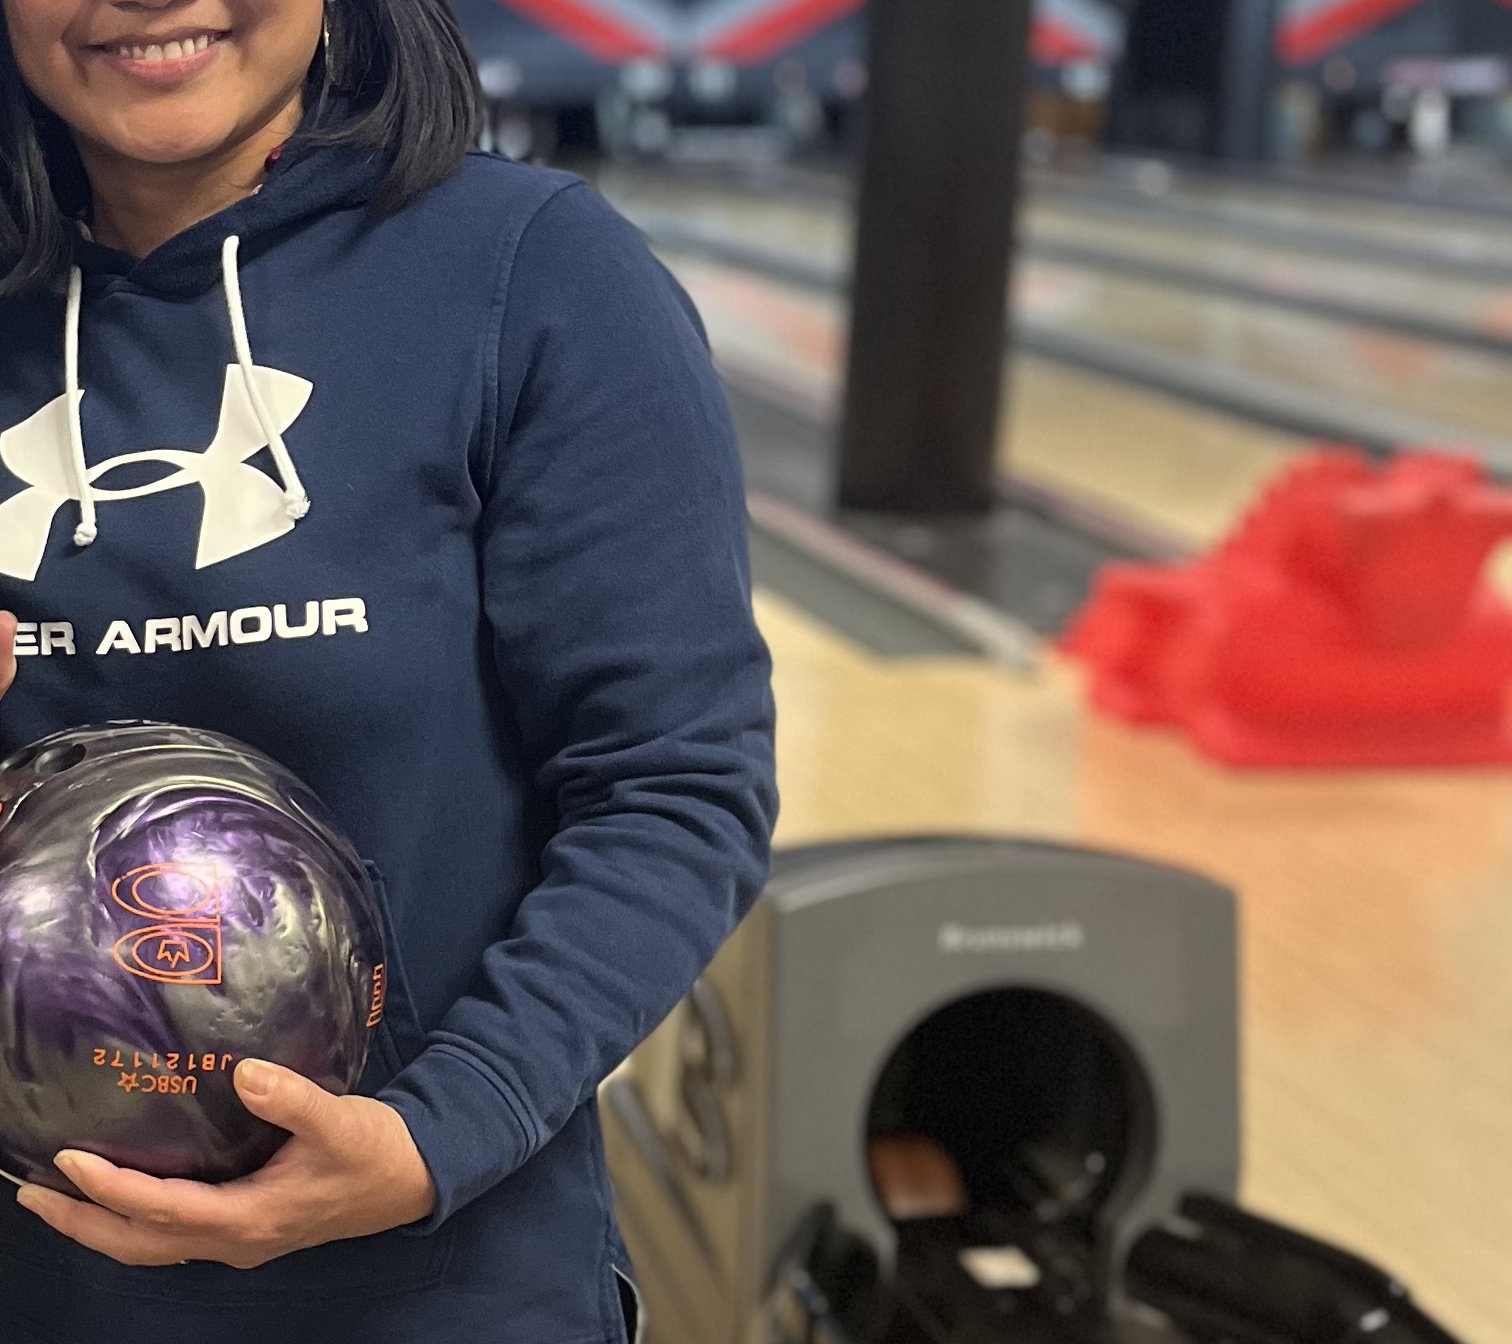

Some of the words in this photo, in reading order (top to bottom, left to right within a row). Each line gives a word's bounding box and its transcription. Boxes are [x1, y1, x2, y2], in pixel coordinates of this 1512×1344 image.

[95, 596, 370, 655] ARMOUR
[93, 1048, 234, 1071] JB121172
[141, 1074, 198, 1095] USBC
